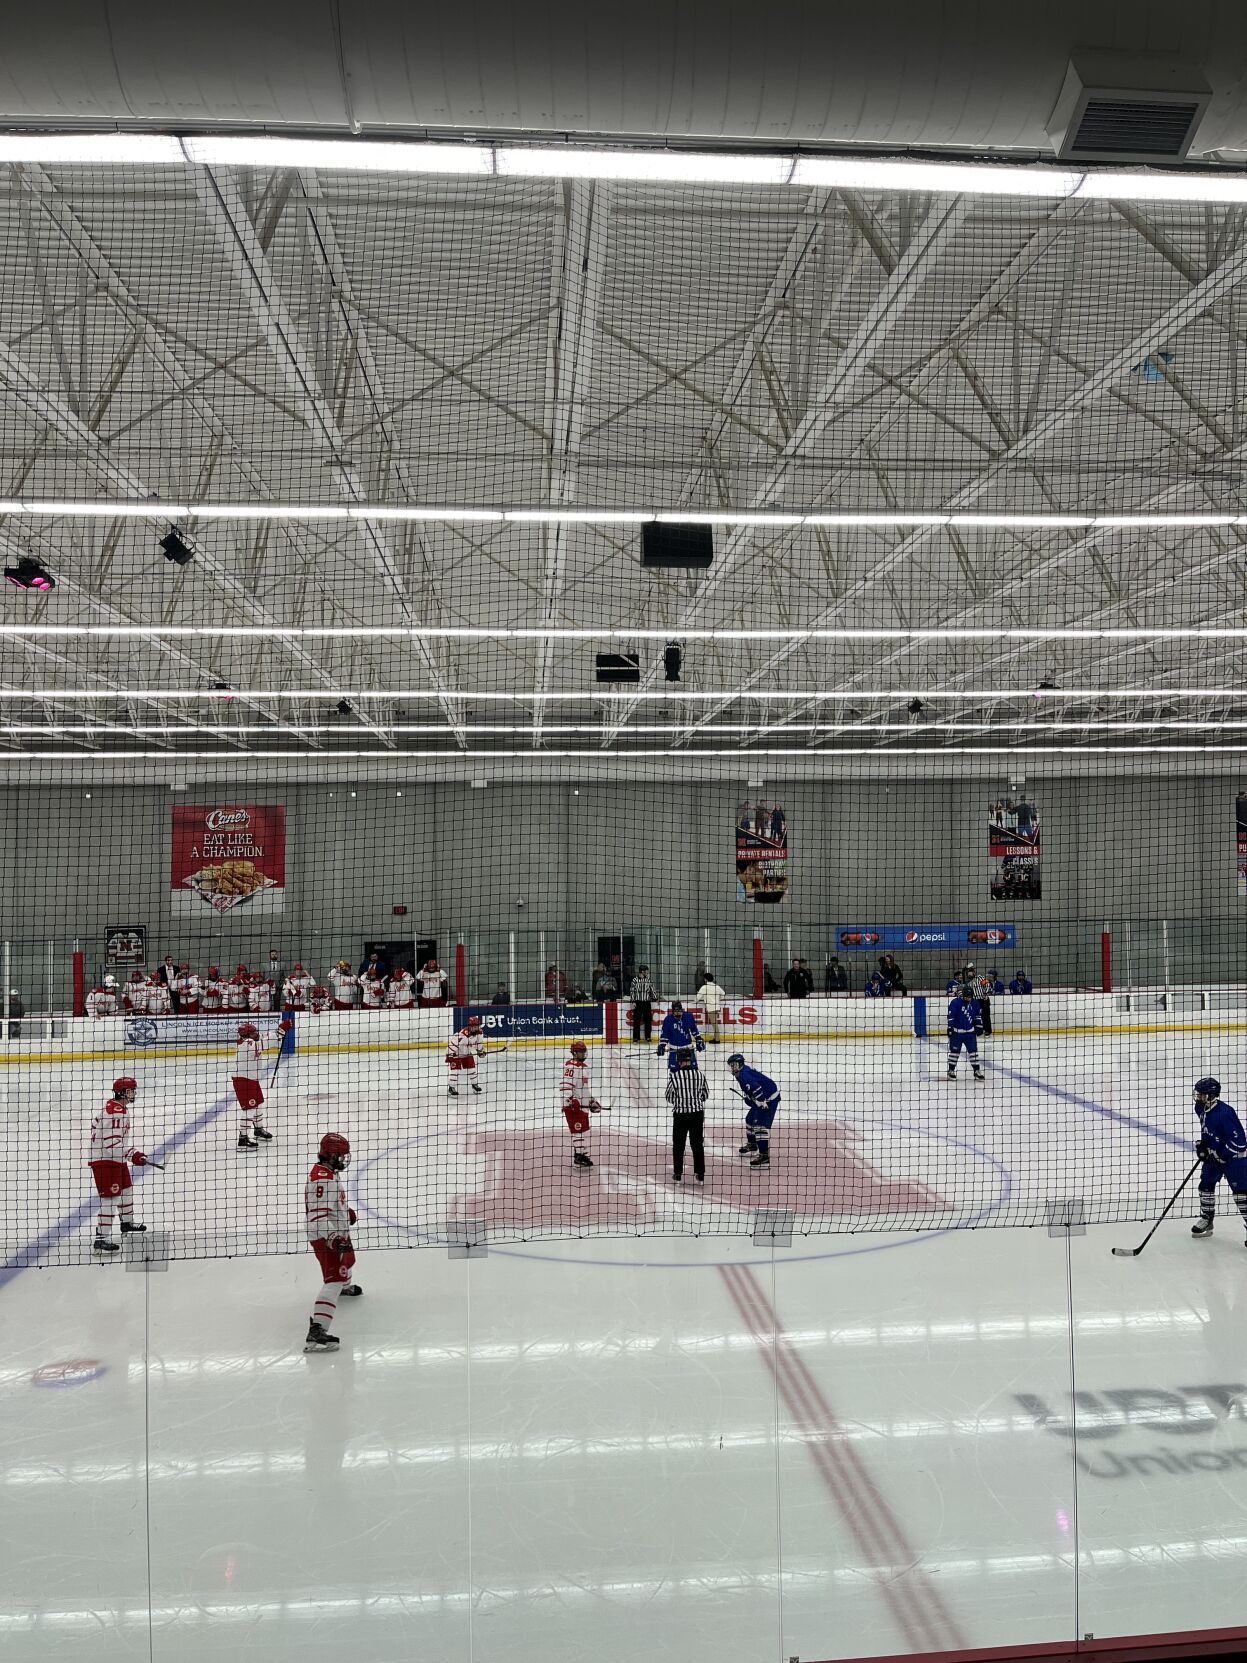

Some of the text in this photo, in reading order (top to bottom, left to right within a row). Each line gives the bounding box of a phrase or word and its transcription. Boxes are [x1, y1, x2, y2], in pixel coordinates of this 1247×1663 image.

[203, 833, 253, 845] EAT LIKE
[190, 846, 200, 858] A
[737, 850, 785, 858] PRIVATE RENTALS
[1006, 846, 1039, 855] LESSONS &
[919, 932, 946, 943] pepsi
[507, 1016, 531, 1026] Union
[532, 1015, 553, 1025] Bank
[625, 1006, 758, 1027] SCELS
[563, 1068, 575, 1079] 20
[111, 1119, 121, 1129] 11
